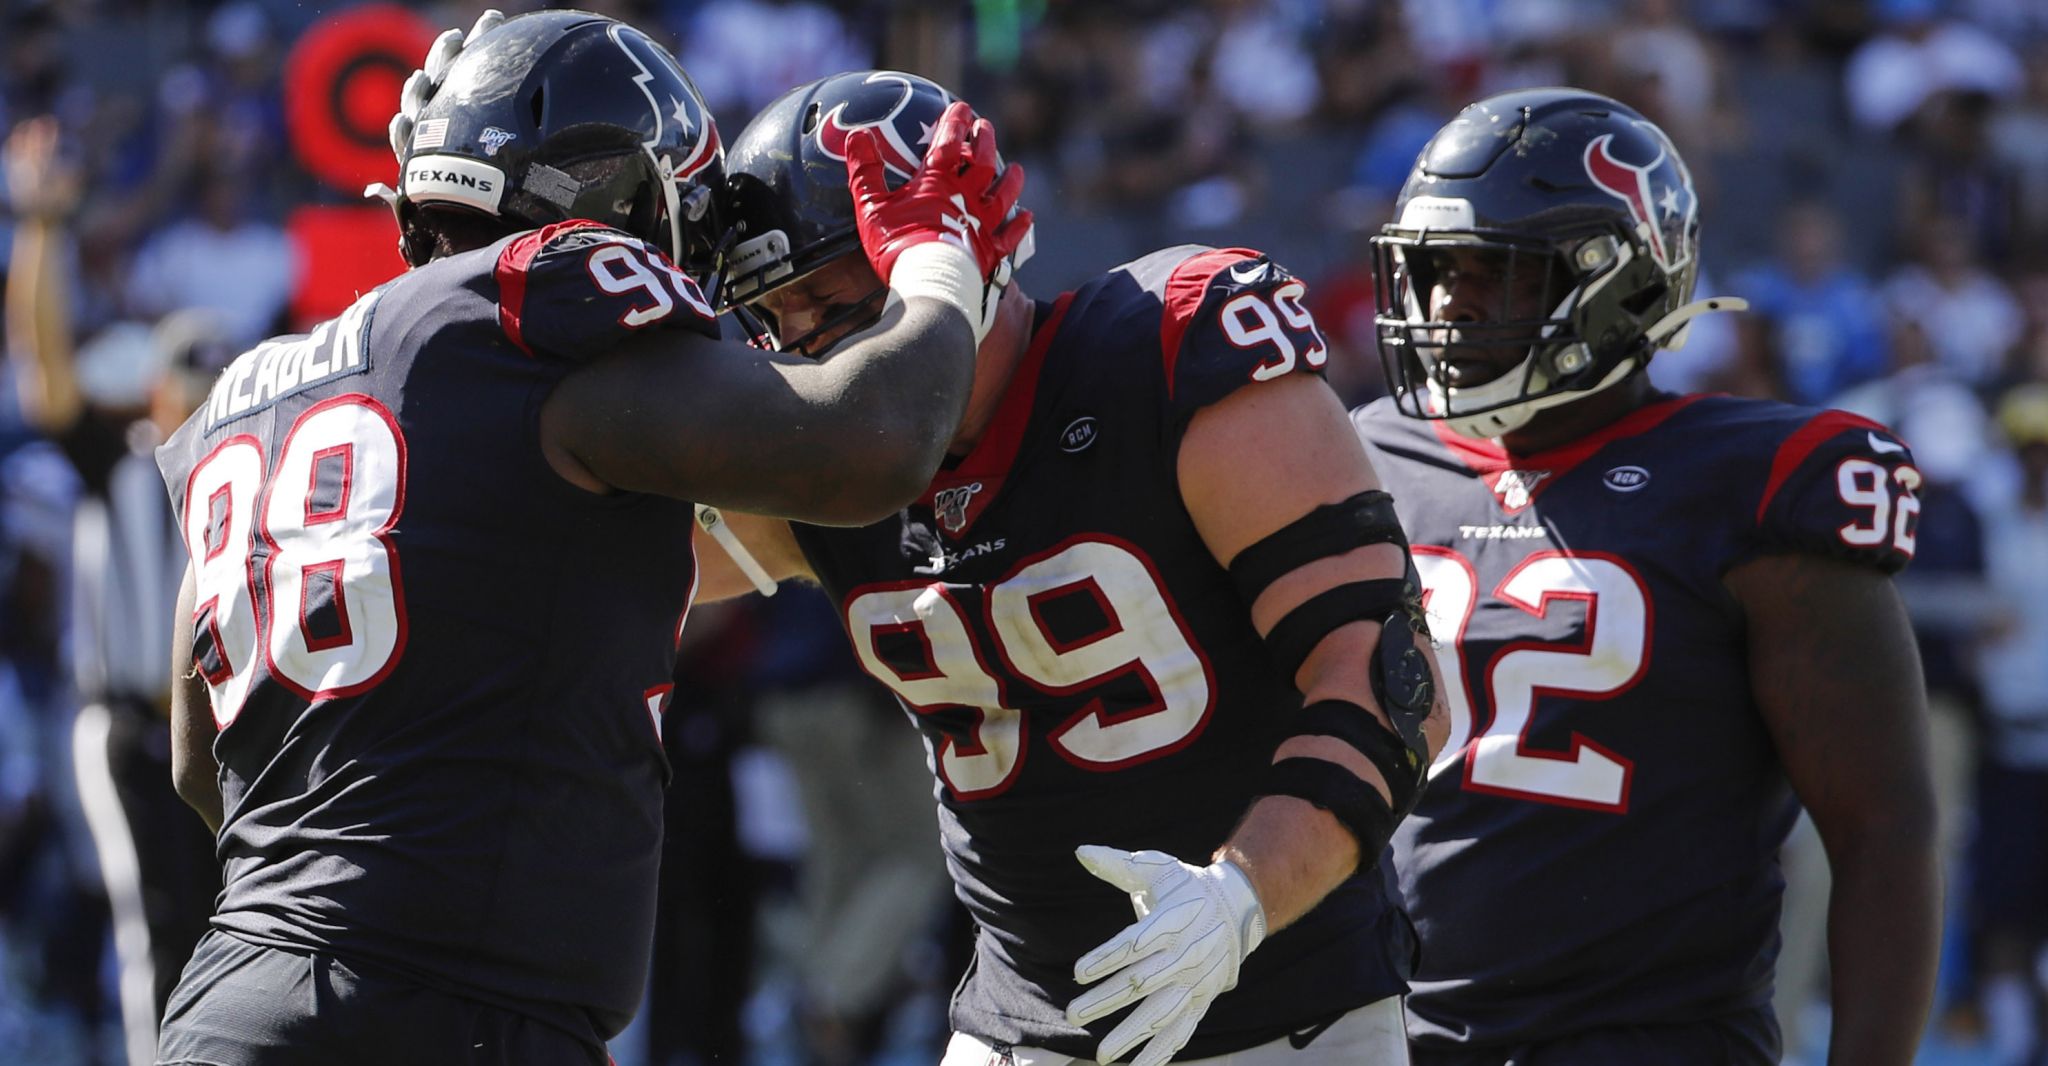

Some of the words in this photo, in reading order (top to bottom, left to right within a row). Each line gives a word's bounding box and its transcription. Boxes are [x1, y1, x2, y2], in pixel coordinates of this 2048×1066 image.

[409, 170, 494, 193] TEXANS
[1218, 279, 1328, 383] 99
[1458, 525, 1546, 540] TEXANS
[1834, 455, 1922, 561] 92
[184, 392, 409, 731] 98
[843, 532, 1217, 800] 99
